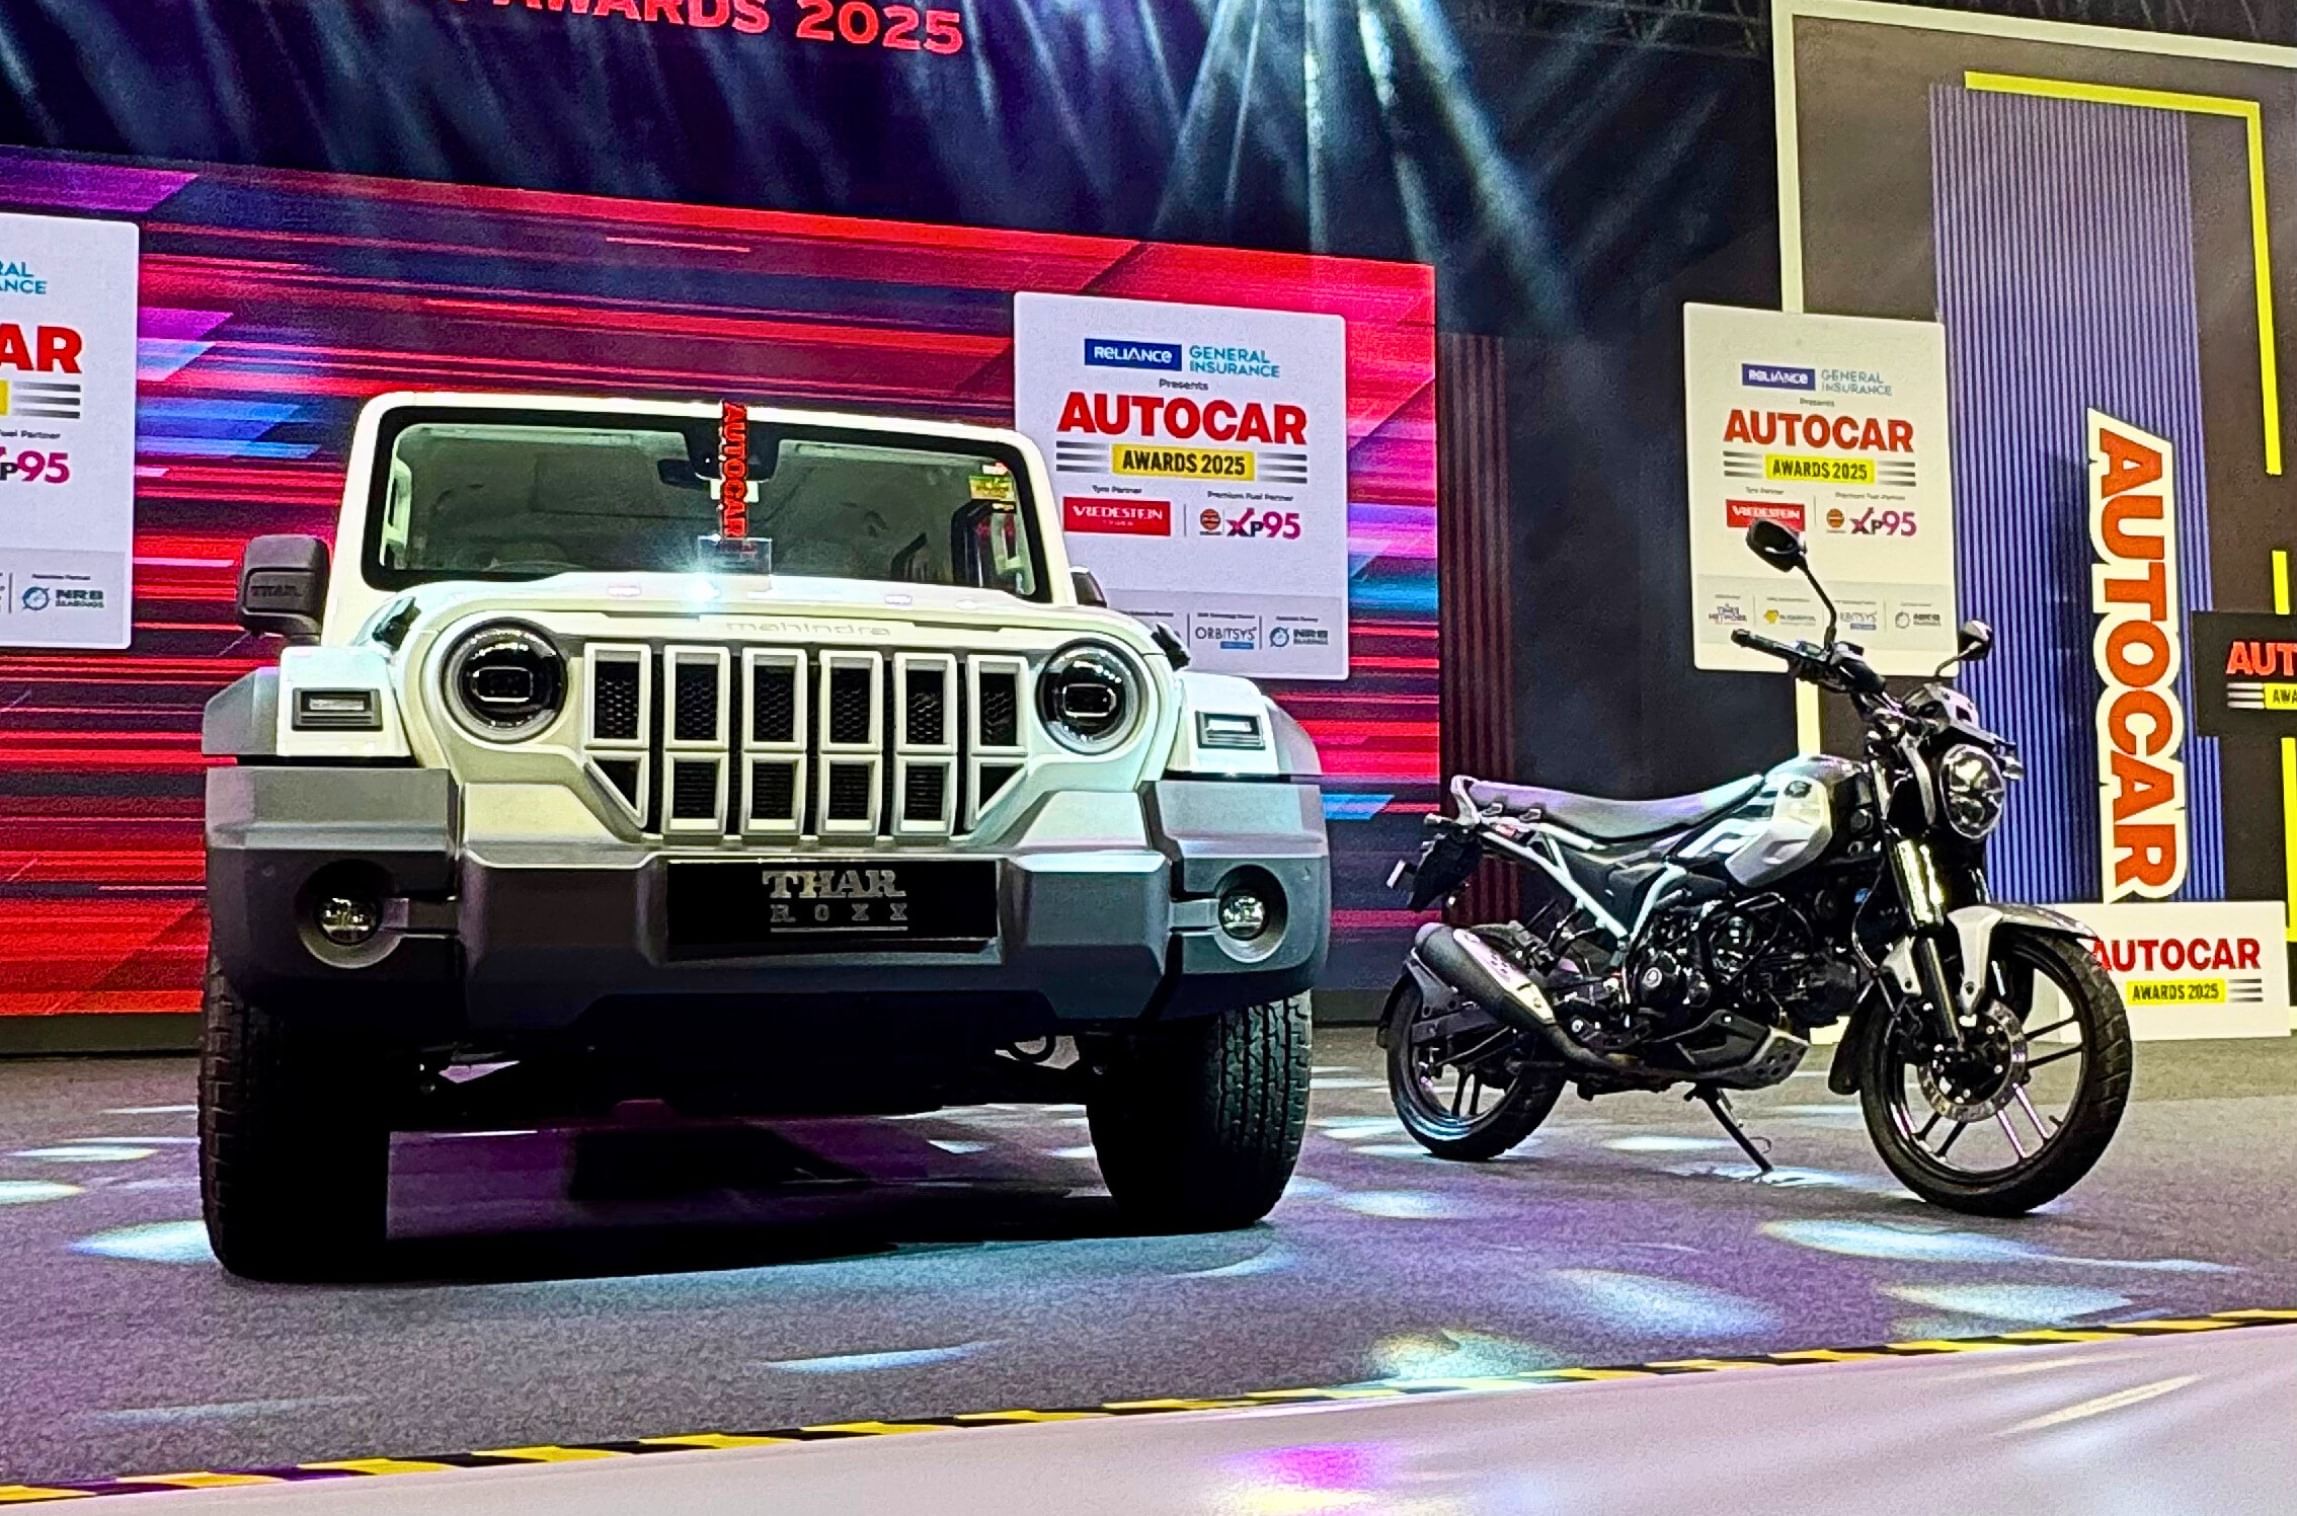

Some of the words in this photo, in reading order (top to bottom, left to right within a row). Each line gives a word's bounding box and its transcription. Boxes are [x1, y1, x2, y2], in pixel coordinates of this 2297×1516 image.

[493, 0, 770, 33] RDS
[796, 0, 963, 54] 2025
[0, 279, 48, 294] NCE
[1189, 345, 1271, 364] GENERAL
[1190, 361, 1280, 378] INSURANCE
[1821, 369, 1884, 383] GENERAL
[1159, 378, 1208, 391] Presents
[1822, 382, 1892, 396] INSURANCE
[1057, 391, 1308, 445] AUTOCAR
[1723, 408, 1914, 453] AUTOCAR
[0, 446, 69, 484] P95
[1122, 450, 1197, 474] AWARDS
[1201, 453, 1245, 475] 2025
[1772, 459, 1830, 478] AWARDS
[1833, 463, 1867, 480] 2025
[726, 621, 891, 637] mahindra
[2099, 427, 2177, 888] AUTOCAR
[762, 869, 907, 899] THAR
[2092, 937, 2261, 973] AUTOCAR
[2132, 984, 2185, 1001] AWARDS
[2188, 983, 2219, 1000] 2025
